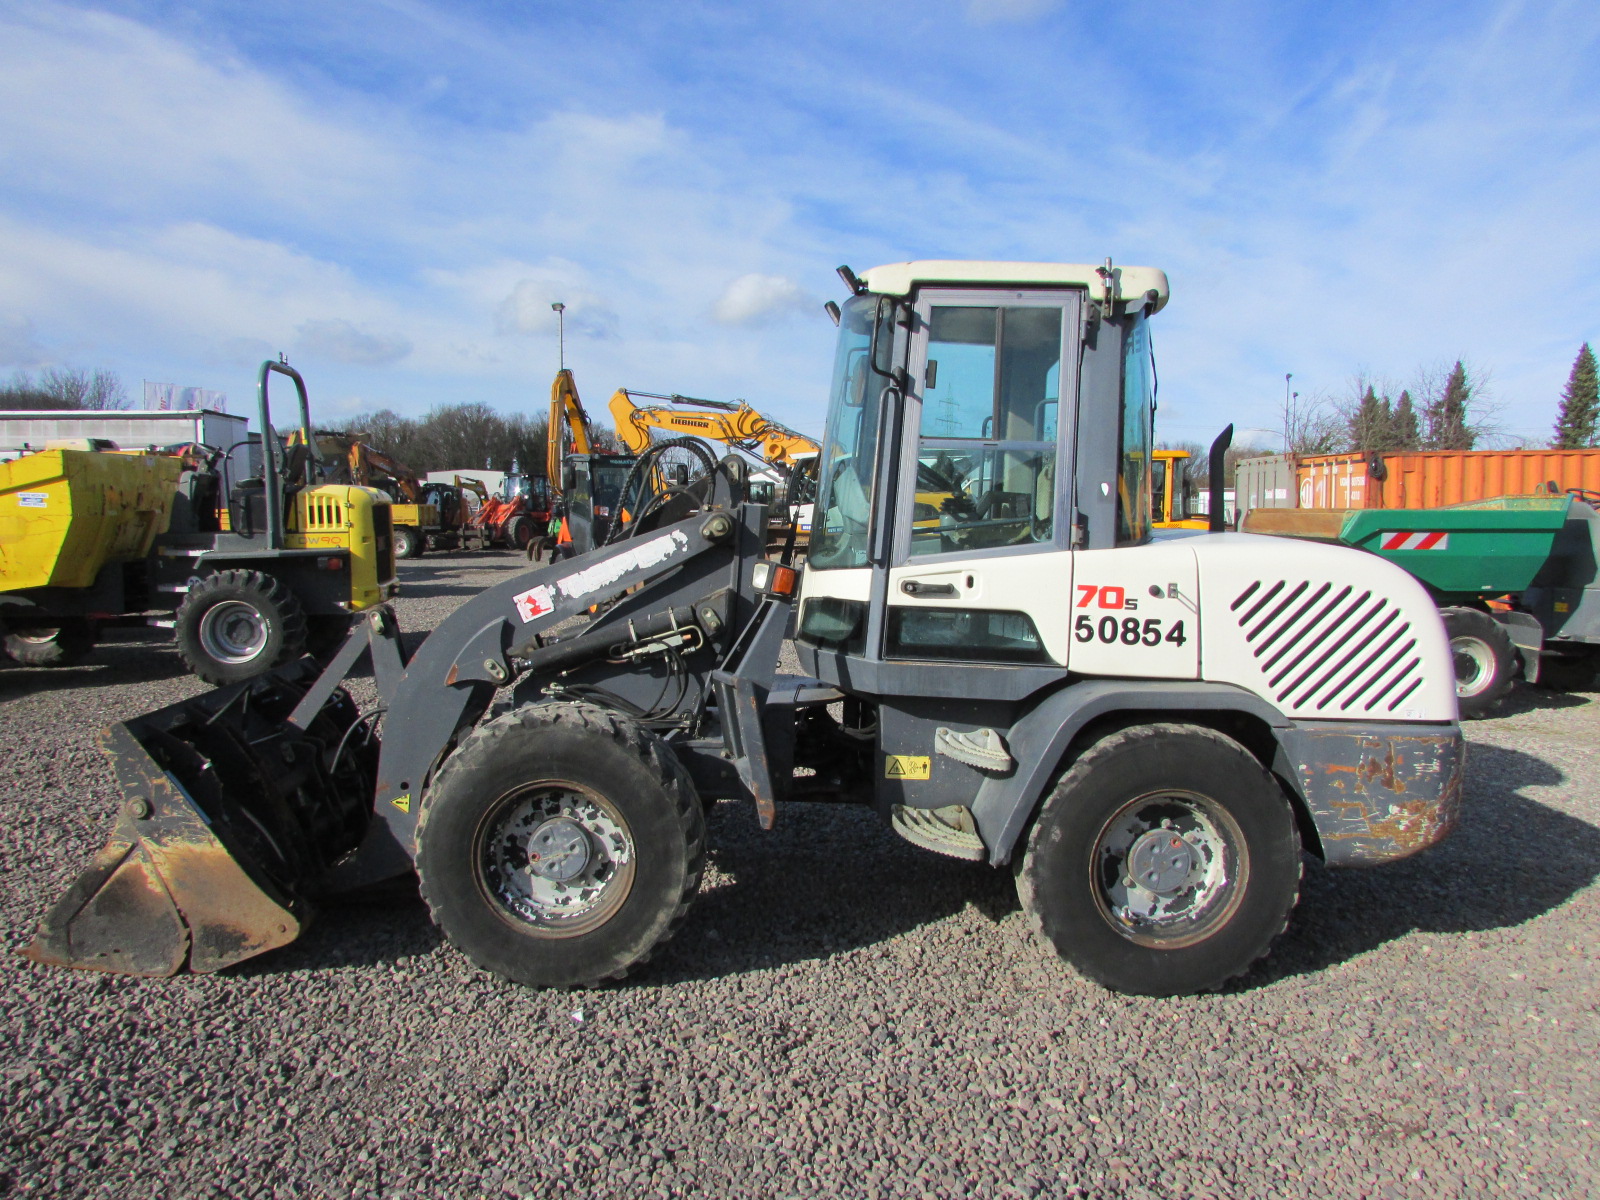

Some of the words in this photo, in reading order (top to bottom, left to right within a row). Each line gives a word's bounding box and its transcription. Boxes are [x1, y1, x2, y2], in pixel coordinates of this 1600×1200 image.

[671, 418, 709, 428] LIEBHERR
[298, 536, 342, 545] DW90
[1075, 615, 1187, 647] 50854
